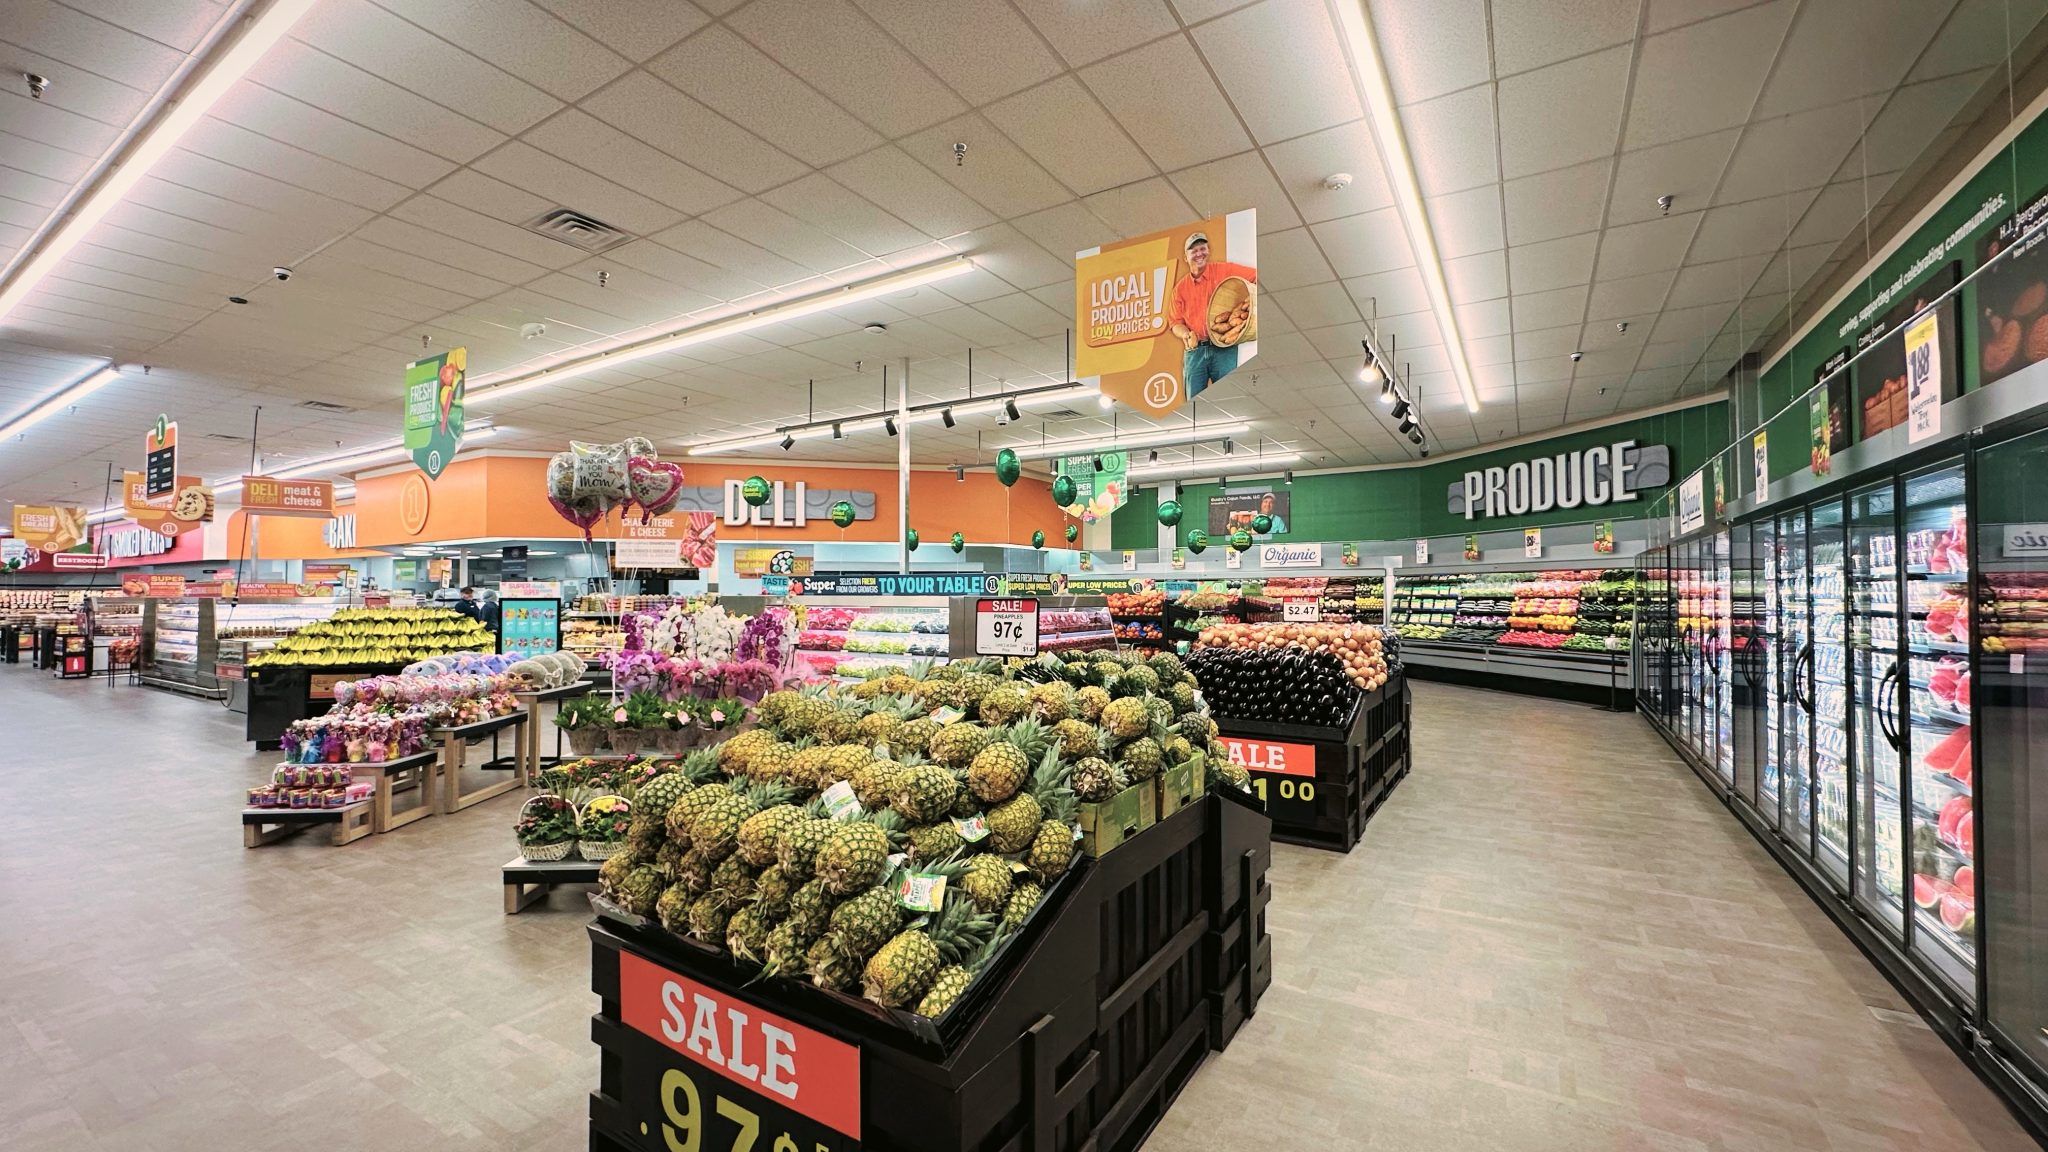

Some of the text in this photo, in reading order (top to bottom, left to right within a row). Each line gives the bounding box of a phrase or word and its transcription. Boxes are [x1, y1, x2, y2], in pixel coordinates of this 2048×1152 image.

[2015, 193, 2048, 227] Bergero
[1890, 274, 1904, 298] and
[1903, 242, 1944, 286] celebrating
[1944, 193, 2007, 252] communities.
[1091, 272, 1151, 307] LOCAL
[1091, 298, 1151, 327] PRODUCE
[1091, 316, 1150, 339] LOW PRICES
[410, 382, 432, 404] FRESH
[1067, 455, 1092, 466] SUPER
[1067, 464, 1092, 474] FRESH
[580, 476, 615, 488] Mom
[1464, 439, 1638, 520] PRODUCE
[250, 482, 321, 496] DELI meat &
[250, 496, 323, 507] FRESH cheese
[20, 514, 49, 522] FRESH
[622, 518, 674, 528] CHARTERIE
[329, 513, 356, 549] BAK
[630, 528, 667, 537] & CHEESE
[1264, 546, 1317, 565] Organic
[762, 577, 788, 586] TASTE
[804, 576, 985, 595] Super SELECTION FRESH TO YOUR TABLE!
[1020, 574, 1032, 583] FRESH
[1067, 581, 1127, 590] UPER LOW PRICES
[1008, 582, 1051, 591] SUPER LOW PRICES
[992, 600, 1023, 612] SALE!
[1288, 606, 1315, 616] $2.47
[993, 621, 1023, 643] 97¢
[1228, 742, 1286, 770] ALE
[660, 980, 799, 1101] SALE
